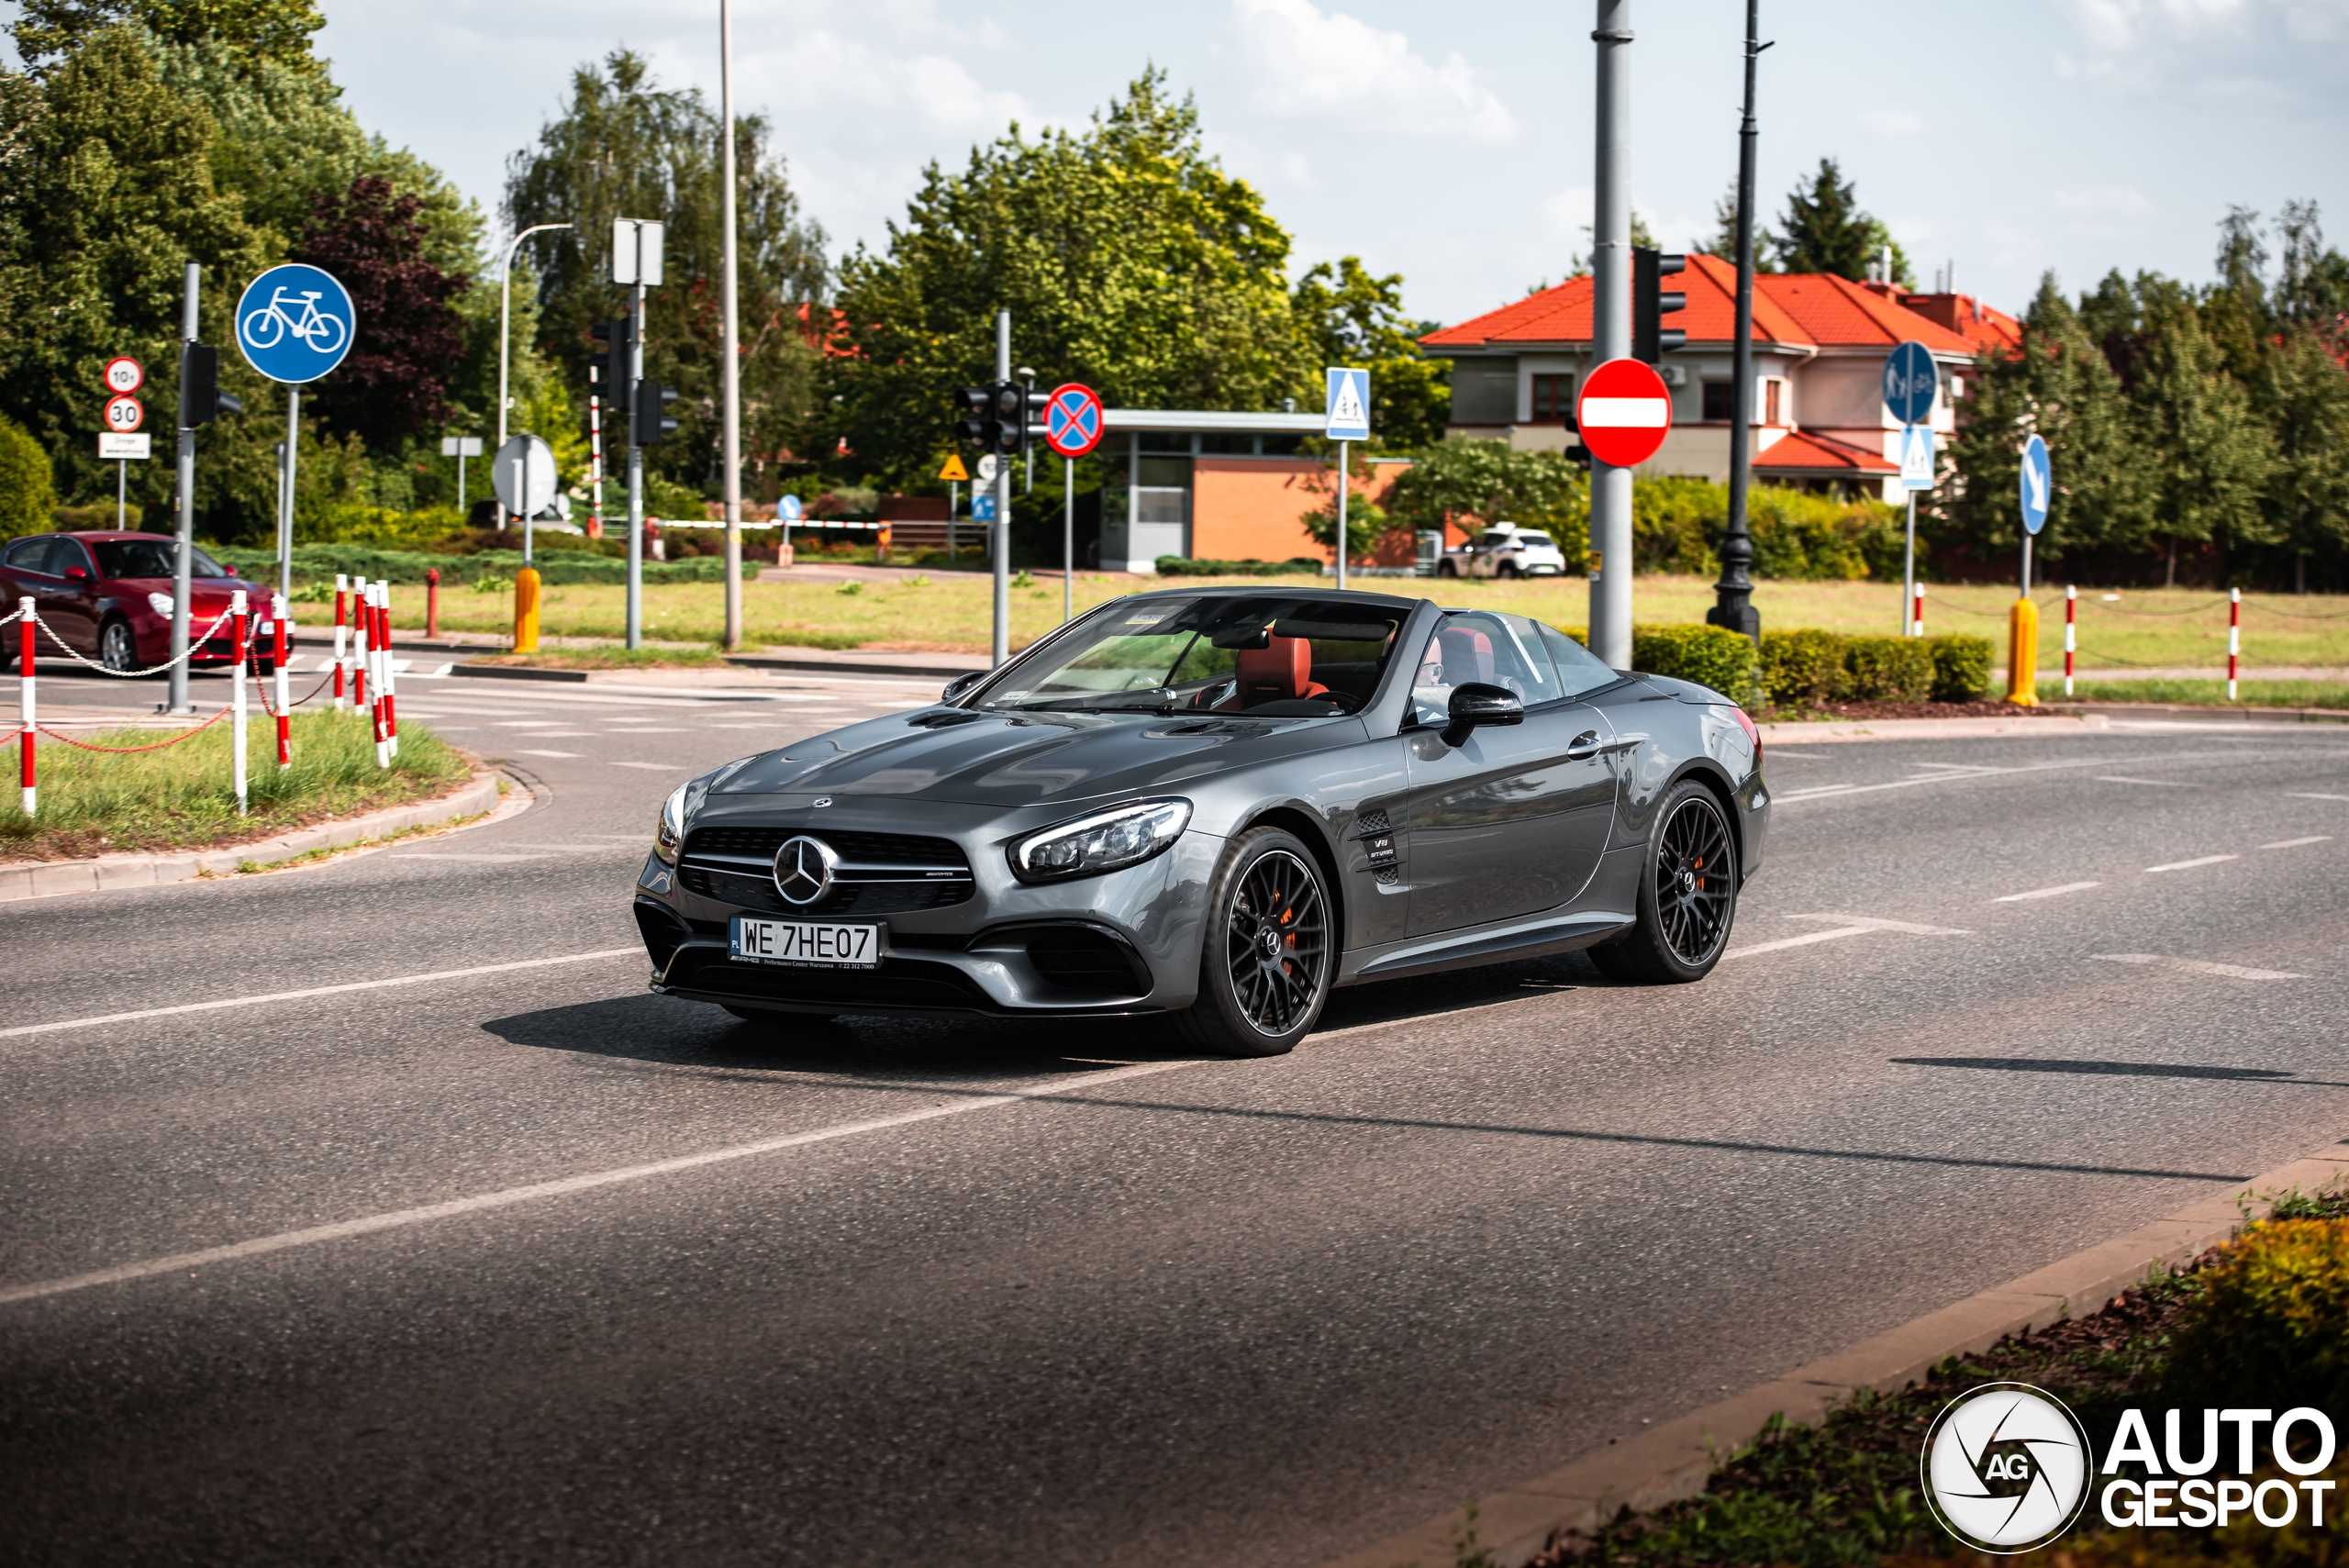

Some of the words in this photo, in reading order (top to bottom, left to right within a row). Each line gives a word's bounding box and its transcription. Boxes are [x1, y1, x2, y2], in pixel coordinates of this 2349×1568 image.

[111, 406, 137, 423] 30
[1374, 839, 1388, 848] V8
[1370, 849, 1394, 858] BITURBO
[731, 940, 740, 949] PL
[744, 921, 774, 955] WE
[782, 925, 870, 960] 7HE07
[739, 956, 760, 964] AMG
[763, 959, 792, 967] Performance
